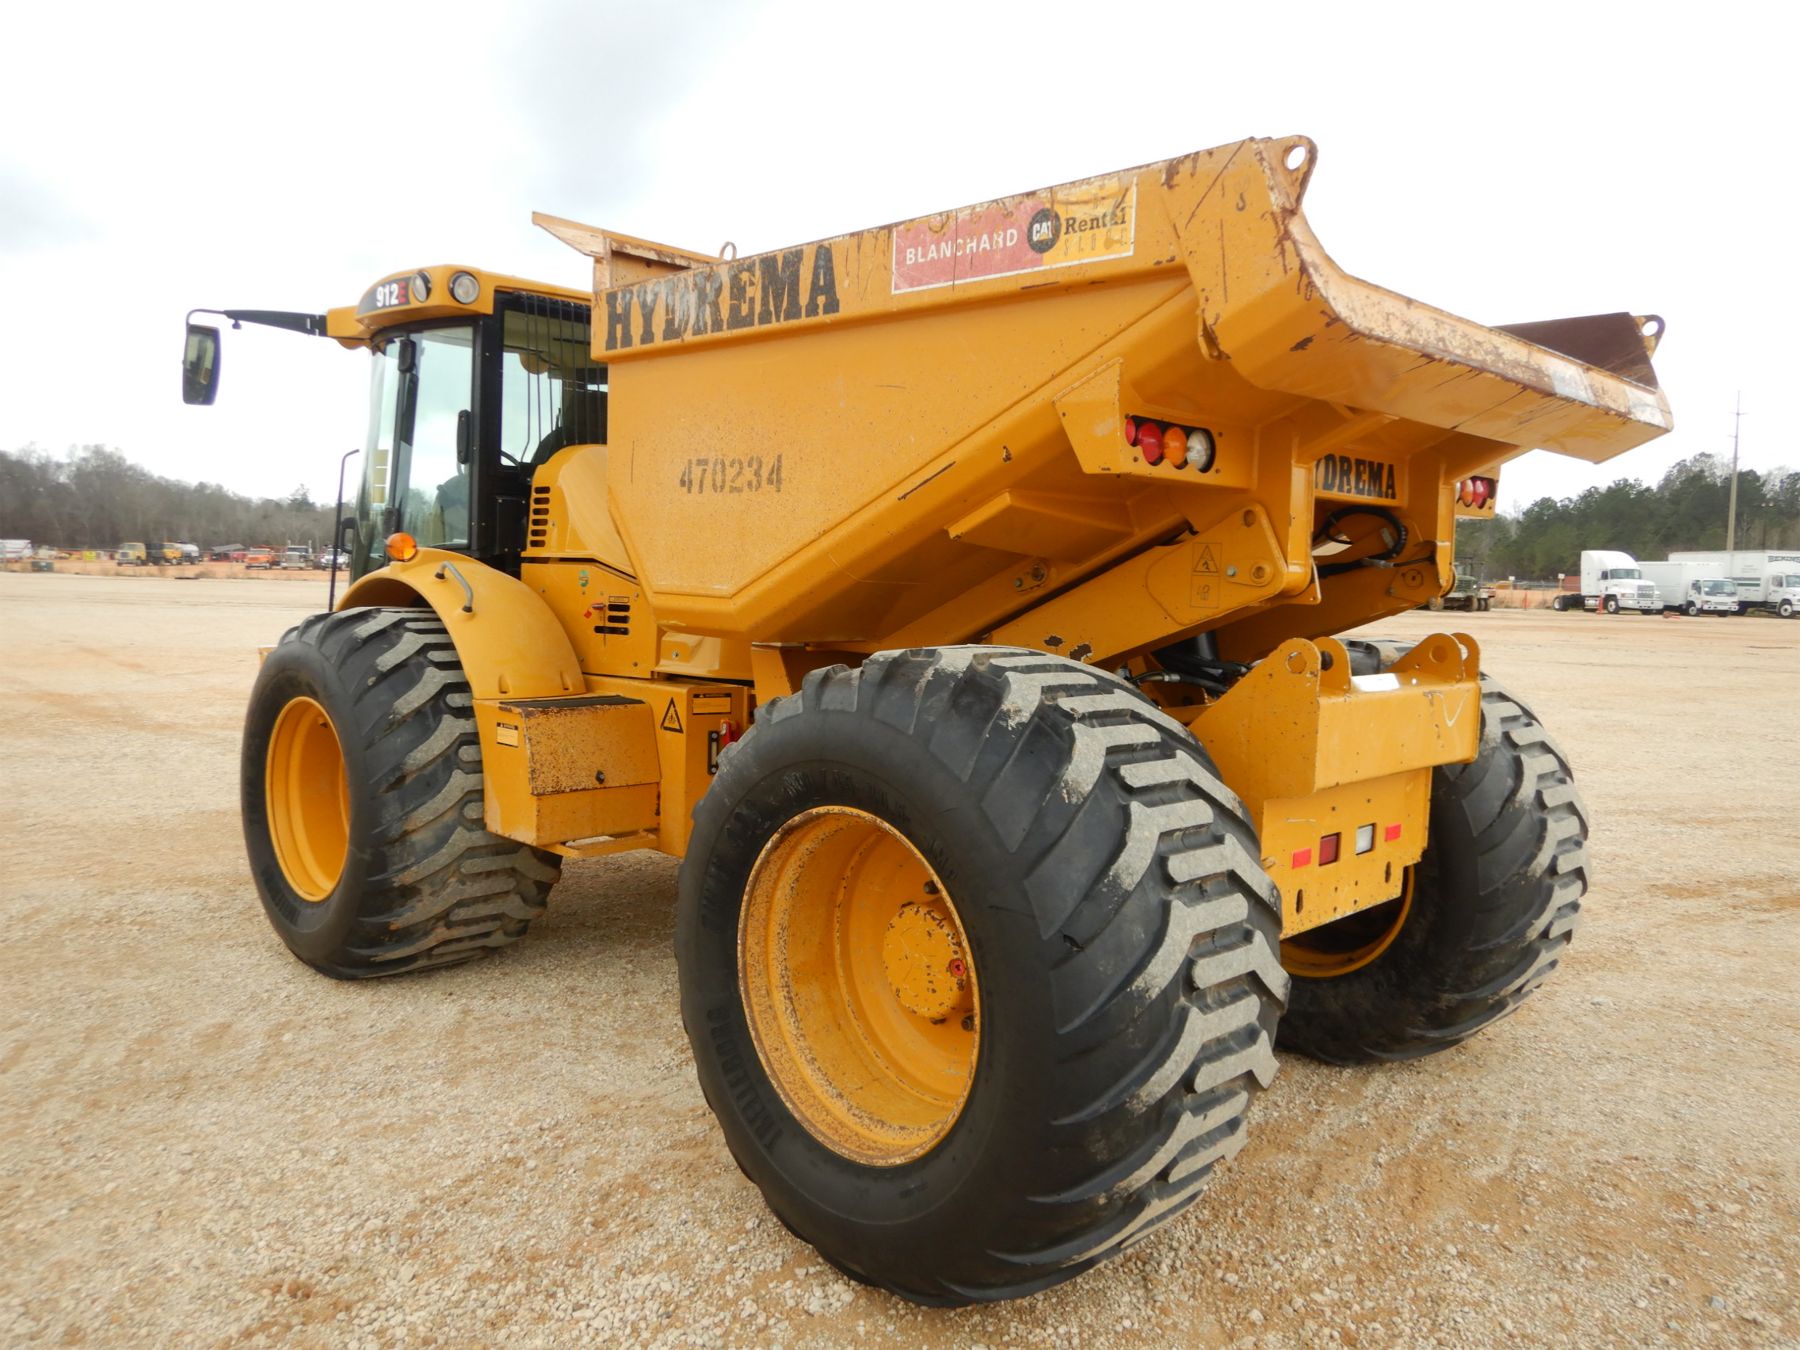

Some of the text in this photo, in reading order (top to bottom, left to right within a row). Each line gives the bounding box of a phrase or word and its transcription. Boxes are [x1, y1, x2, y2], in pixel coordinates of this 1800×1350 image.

[905, 228, 1018, 265] BLANCHARD
[375, 280, 407, 307] 912E
[605, 243, 840, 352] HYDREMA
[679, 453, 783, 494] 470234
